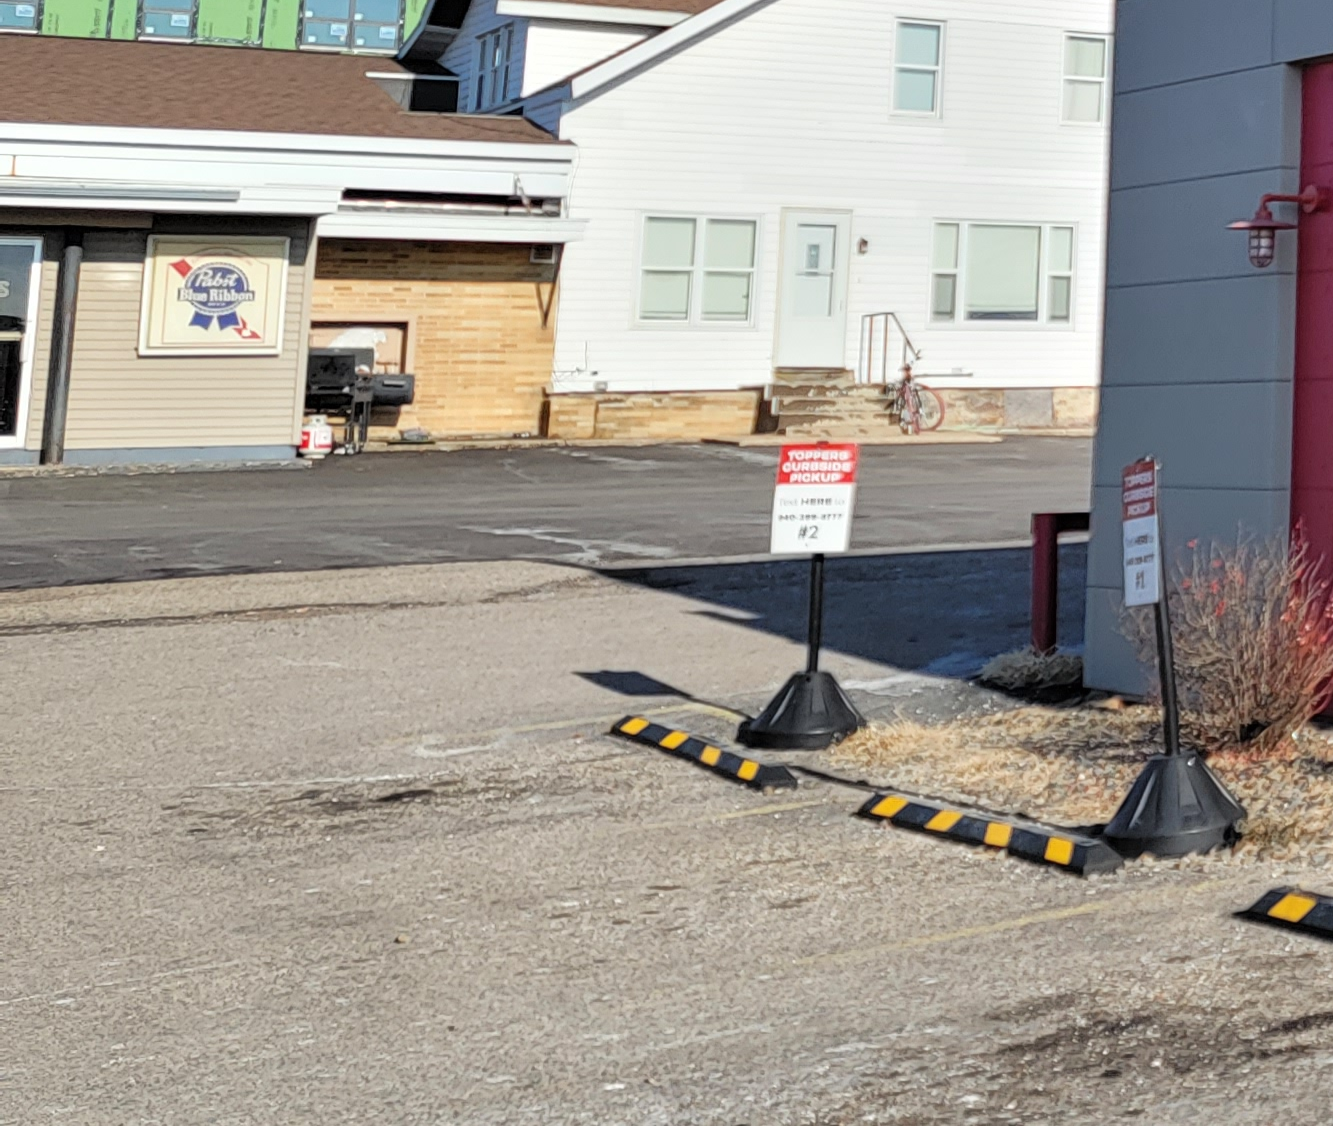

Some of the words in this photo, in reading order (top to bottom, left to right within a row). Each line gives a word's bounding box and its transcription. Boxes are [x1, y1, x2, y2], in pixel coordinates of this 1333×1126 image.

[195, 269, 238, 287] Pabst
[180, 288, 207, 301] Blue
[209, 289, 253, 301] Ribbon
[787, 450, 850, 461] TOPPERS
[782, 461, 852, 473] CURBSIDE
[789, 472, 844, 483] PICKUP
[798, 525, 818, 540] #2
